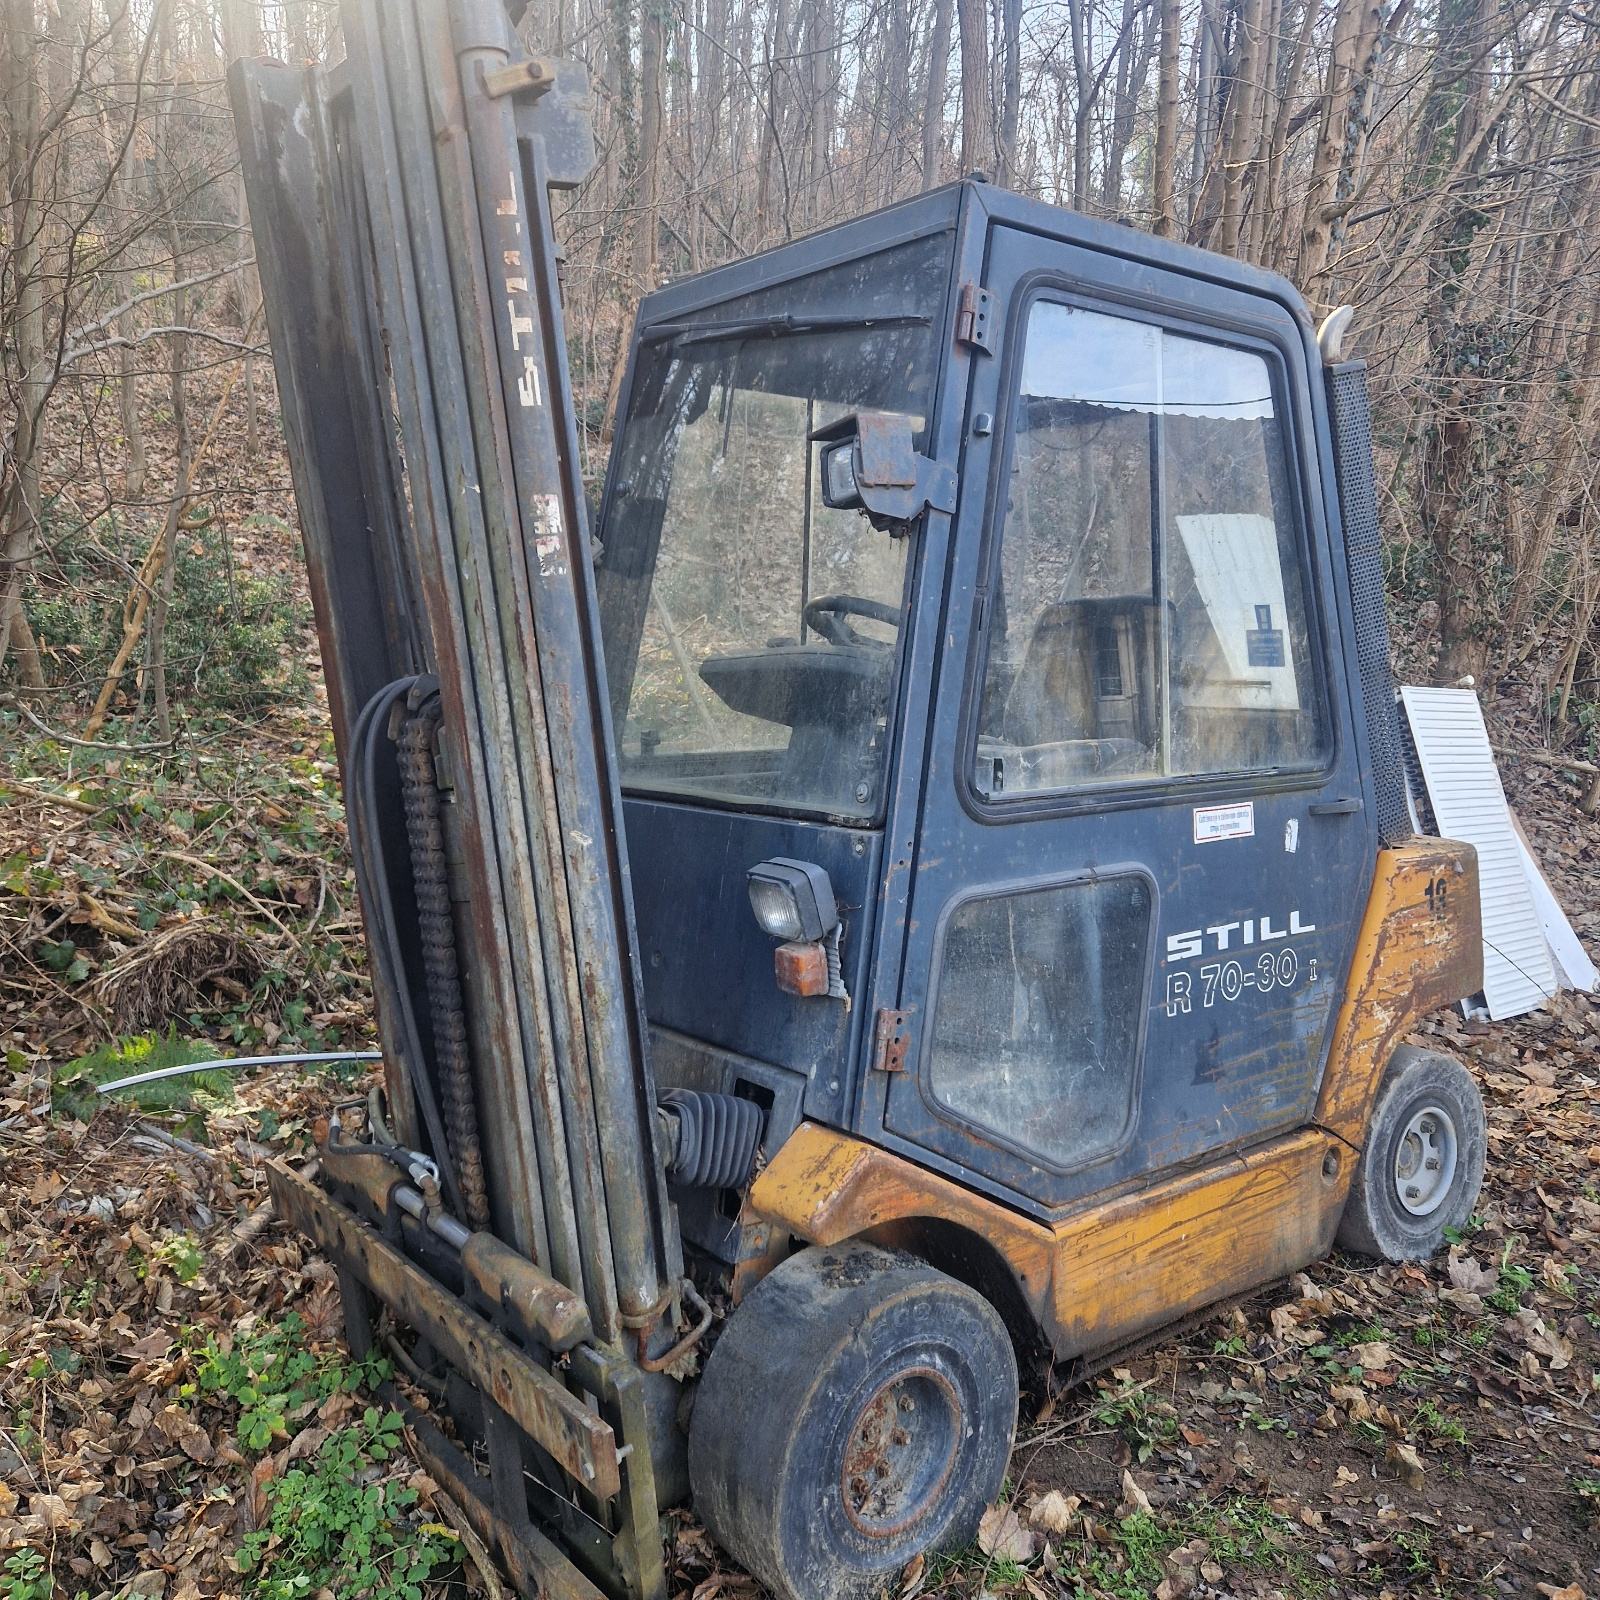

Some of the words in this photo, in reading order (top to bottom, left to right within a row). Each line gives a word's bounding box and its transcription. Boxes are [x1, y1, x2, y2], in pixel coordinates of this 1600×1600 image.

[1167, 910, 1316, 962] STILL
[1166, 971, 1192, 1018] R
[1200, 947, 1298, 1008] 70-30
